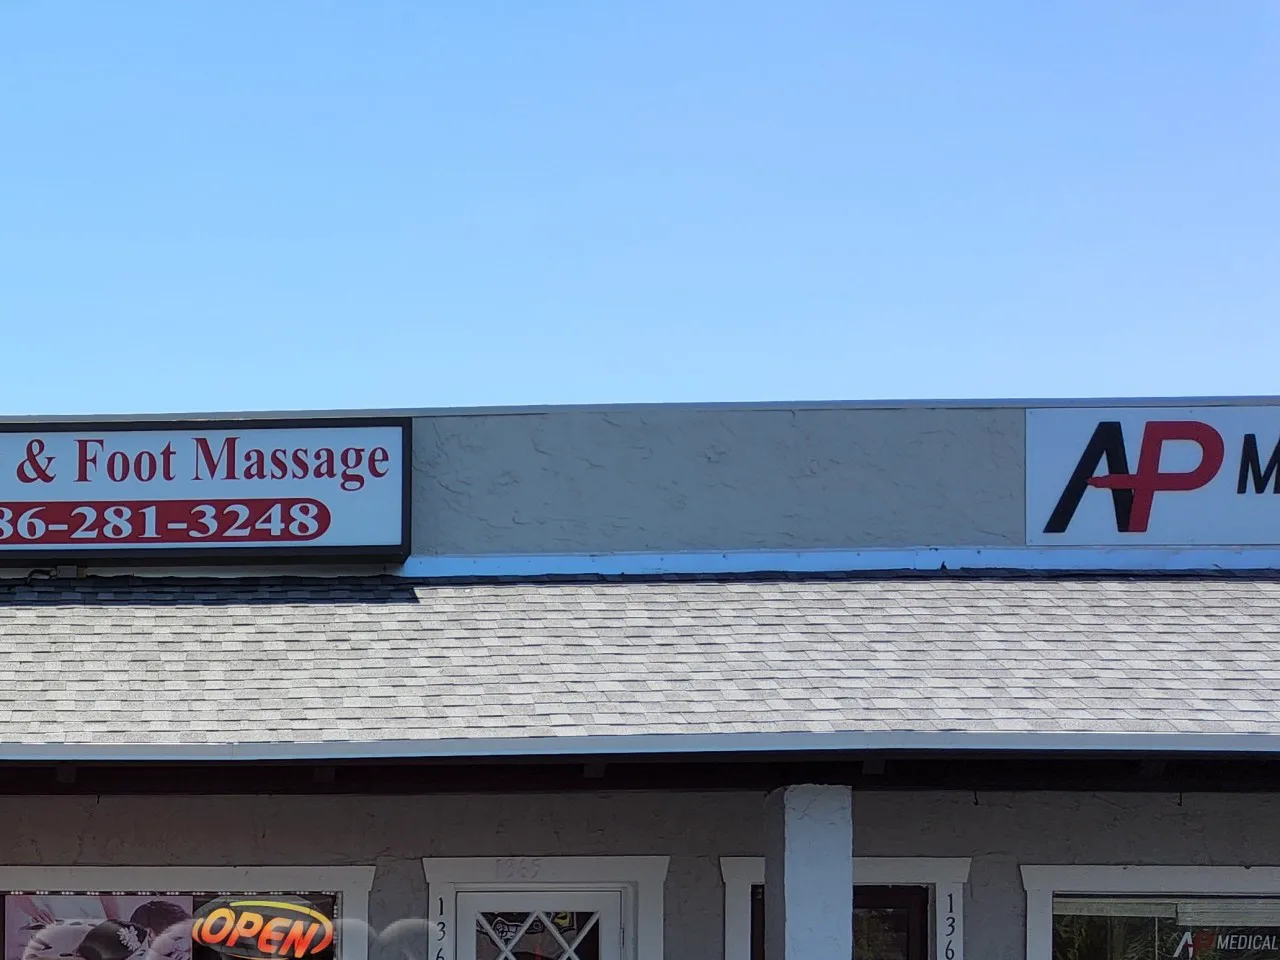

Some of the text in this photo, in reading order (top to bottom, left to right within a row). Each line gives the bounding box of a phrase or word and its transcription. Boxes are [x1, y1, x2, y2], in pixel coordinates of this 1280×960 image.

[16, 438, 57, 483] &
[74, 437, 177, 483] Foot
[191, 436, 390, 491] Massage
[1043, 420, 1225, 533] AP
[201, 908, 320, 958] OPEN
[1217, 934, 1279, 950] MEDICAL
